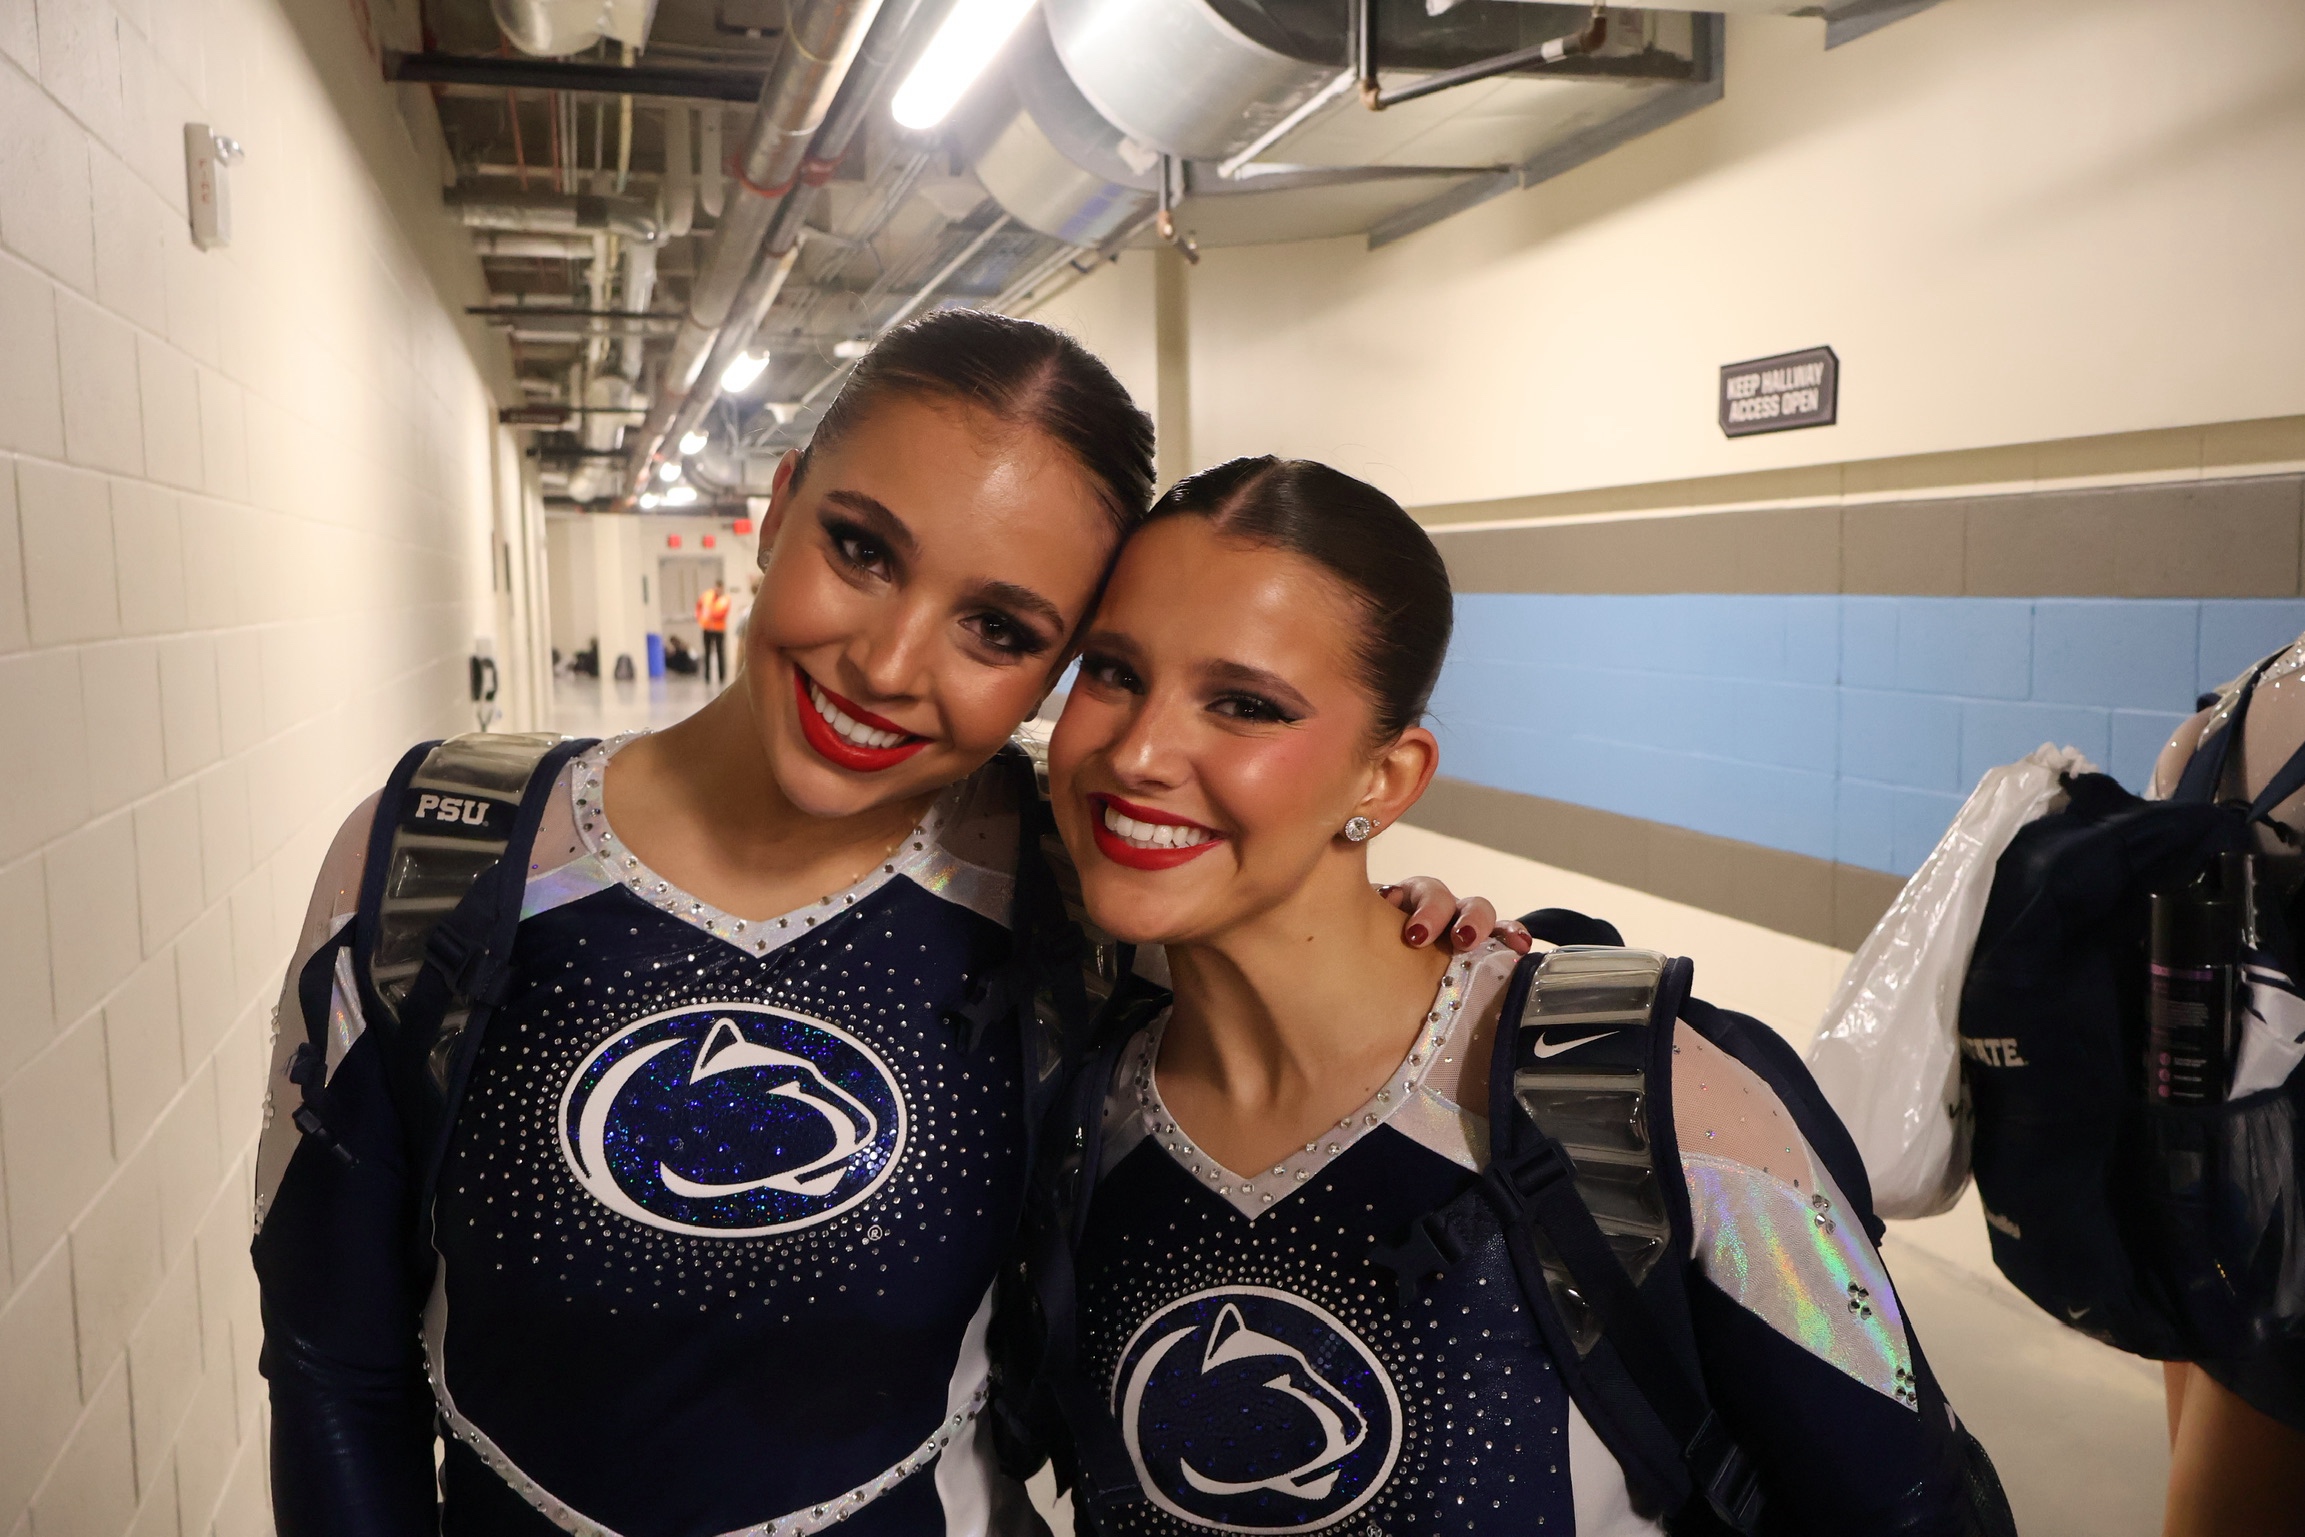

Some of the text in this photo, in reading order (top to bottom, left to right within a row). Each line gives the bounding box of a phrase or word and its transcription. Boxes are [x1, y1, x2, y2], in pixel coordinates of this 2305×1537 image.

[1727, 362, 1824, 400] KEEP HALLWAY
[1728, 388, 1819, 423] ACCESS OPEN
[415, 794, 490, 825] PSU
[1961, 1037, 2025, 1067] TATE
